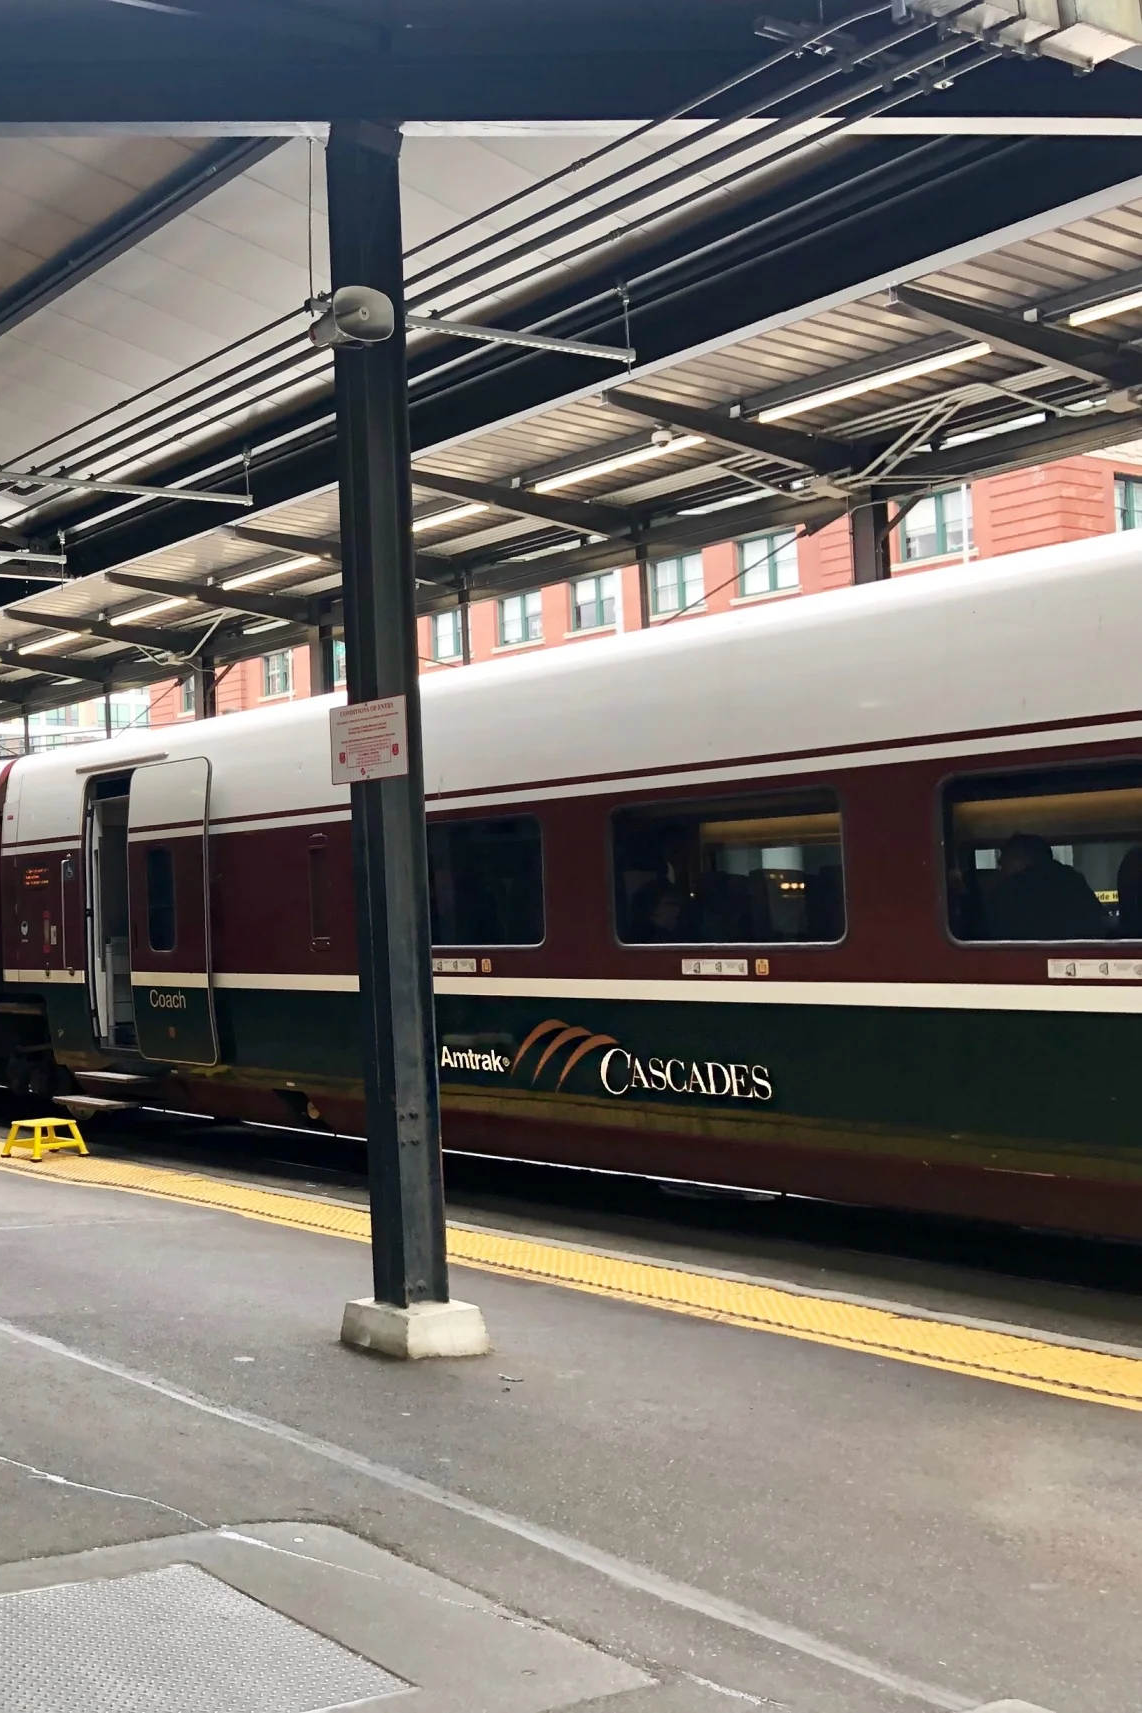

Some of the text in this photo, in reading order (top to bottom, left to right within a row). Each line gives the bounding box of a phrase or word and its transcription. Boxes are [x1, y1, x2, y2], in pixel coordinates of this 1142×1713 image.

[339, 702, 394, 718] CONDITIONS OF ENTRY
[149, 988, 187, 1009] Coach
[600, 1048, 773, 1101] CASCADES
